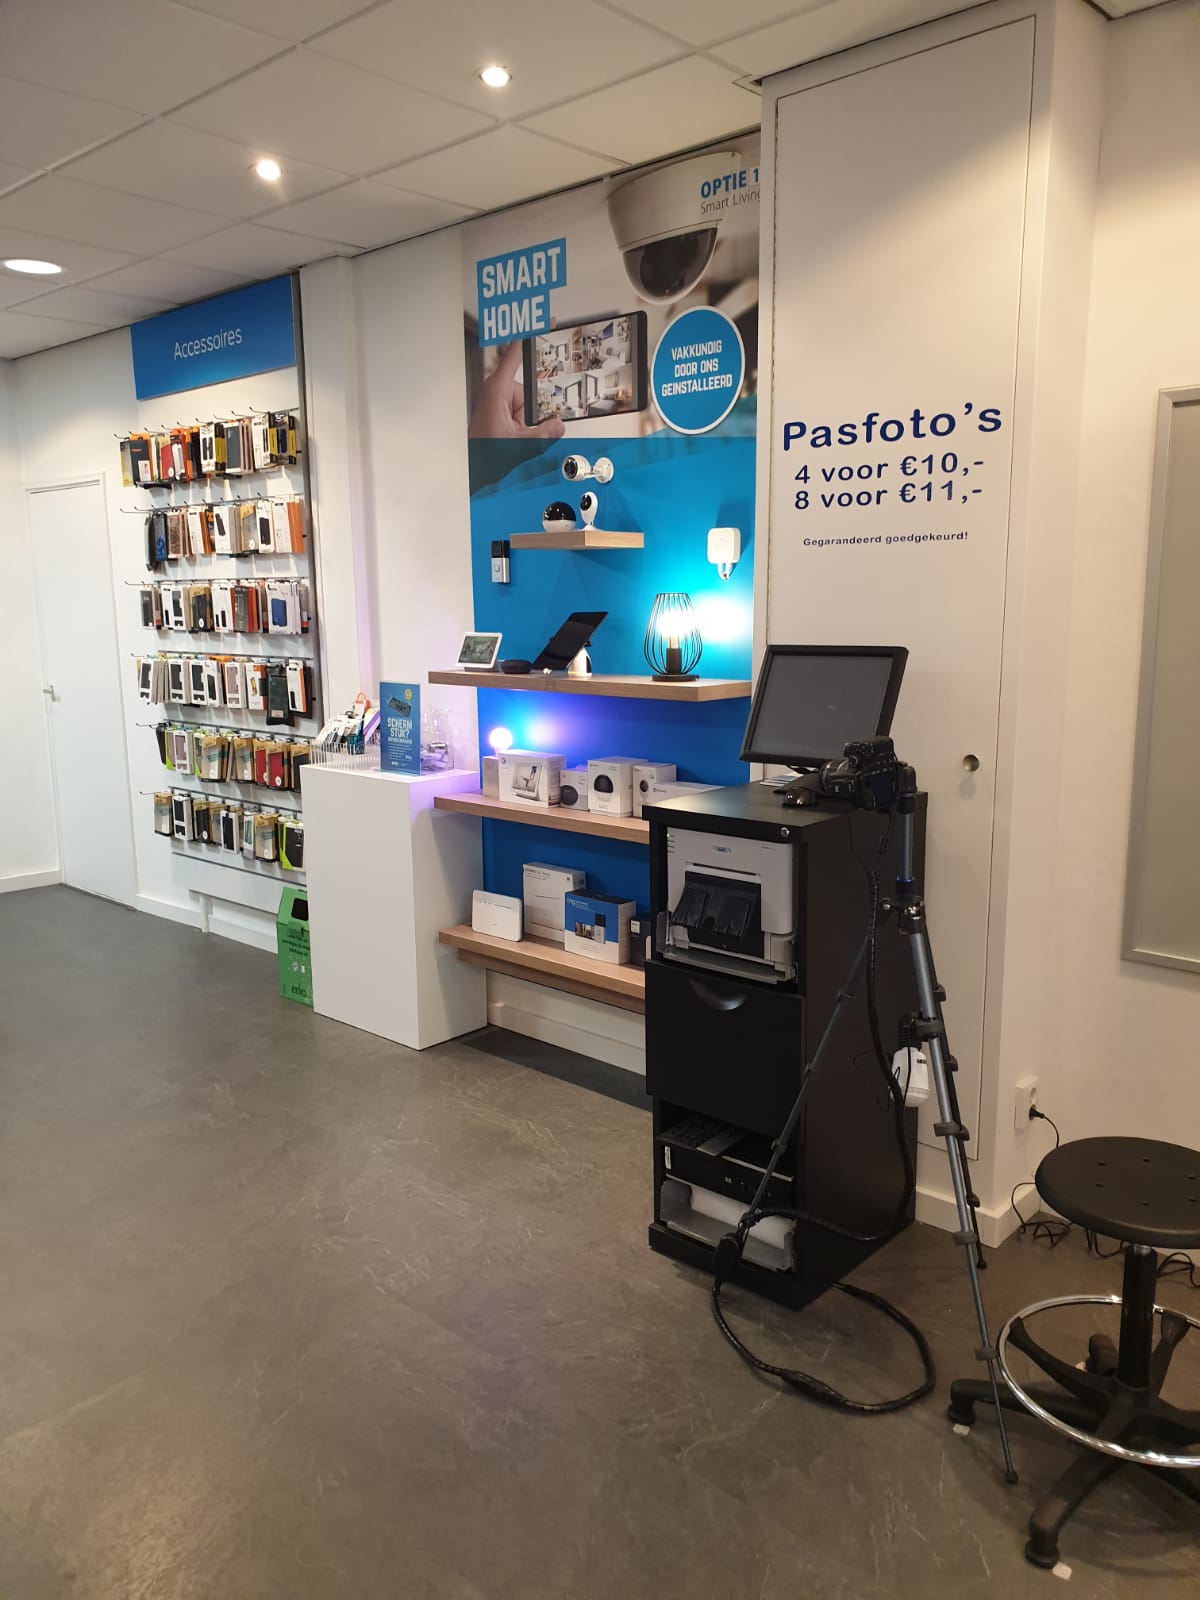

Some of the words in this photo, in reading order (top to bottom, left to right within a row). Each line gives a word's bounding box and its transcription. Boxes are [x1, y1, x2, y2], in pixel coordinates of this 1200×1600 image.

[700, 170, 747, 199] OPTIE
[752, 167, 759, 183] 1
[700, 197, 729, 215] Smart
[482, 247, 561, 298] SMART
[483, 295, 545, 340] HOME
[173, 328, 242, 360] Accessoires
[671, 340, 722, 361] VAKKUNDIG
[674, 365, 698, 378] DOOR
[700, 361, 719, 375] ONS
[661, 374, 733, 397] GEINSTALLEERD
[783, 402, 1002, 451] Pasfoto's
[794, 464, 810, 484] 4
[821, 462, 888, 482] voor
[900, 452, 984, 476] €10,-
[794, 490, 810, 509] 8
[821, 489, 888, 508] voor
[899, 480, 983, 504] €11,-
[803, 535, 882, 547] Gegarandeerd
[885, 531, 969, 544] goedgekeurd!
[387, 717, 413, 730] SCHERM
[390, 727, 410, 738] STUK?
